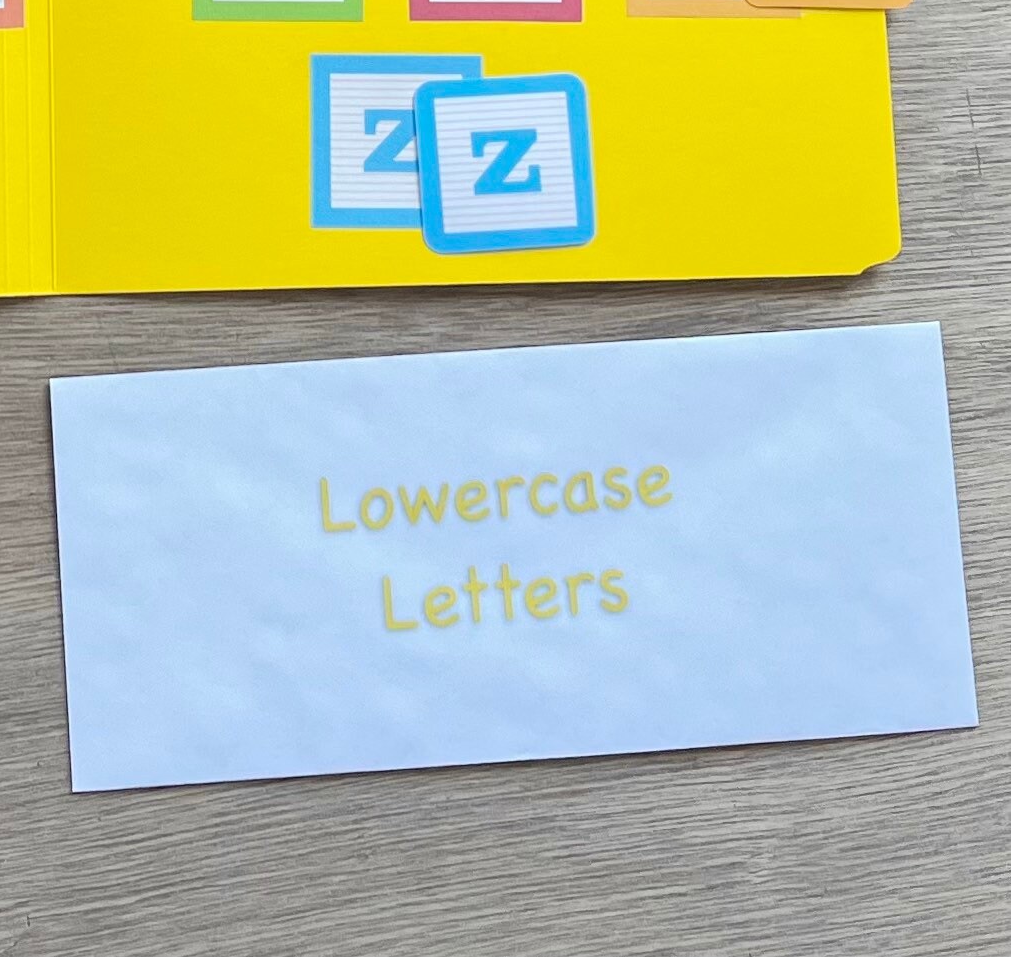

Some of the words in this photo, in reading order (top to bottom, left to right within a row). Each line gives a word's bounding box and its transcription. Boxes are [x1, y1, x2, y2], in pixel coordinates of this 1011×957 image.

[364, 109, 419, 172] z
[471, 129, 541, 195] z
[320, 465, 673, 532] Lowercase
[383, 563, 629, 630] Letters
